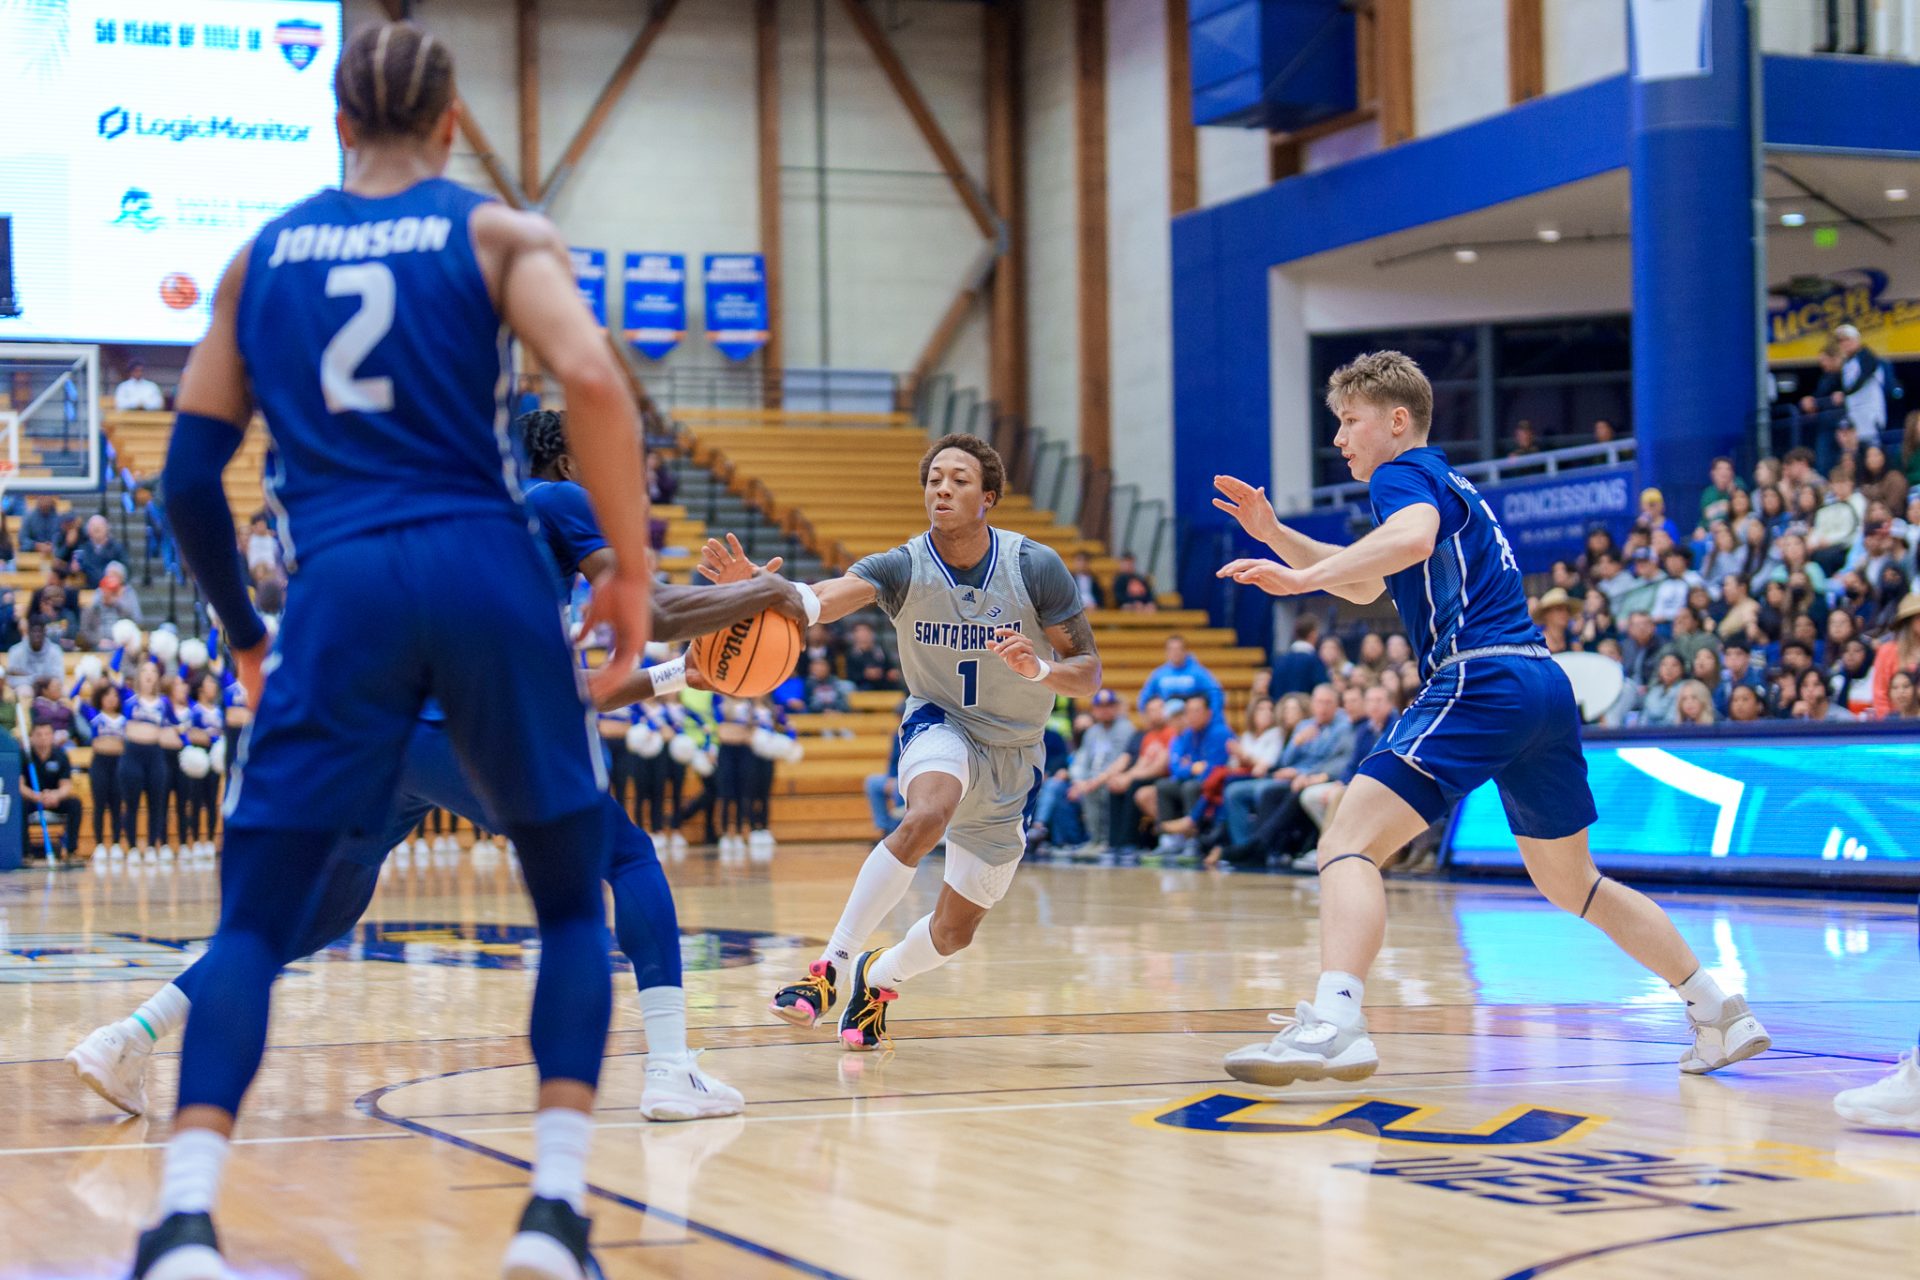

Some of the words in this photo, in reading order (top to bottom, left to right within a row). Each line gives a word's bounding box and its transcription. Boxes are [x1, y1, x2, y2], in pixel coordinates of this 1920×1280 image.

[136, 112, 311, 141] LogicMonitor
[268, 215, 452, 268] JOHNSON
[320, 261, 397, 414] 2
[1503, 479, 1628, 523] CONCESSIONS
[957, 658, 979, 708] 1
